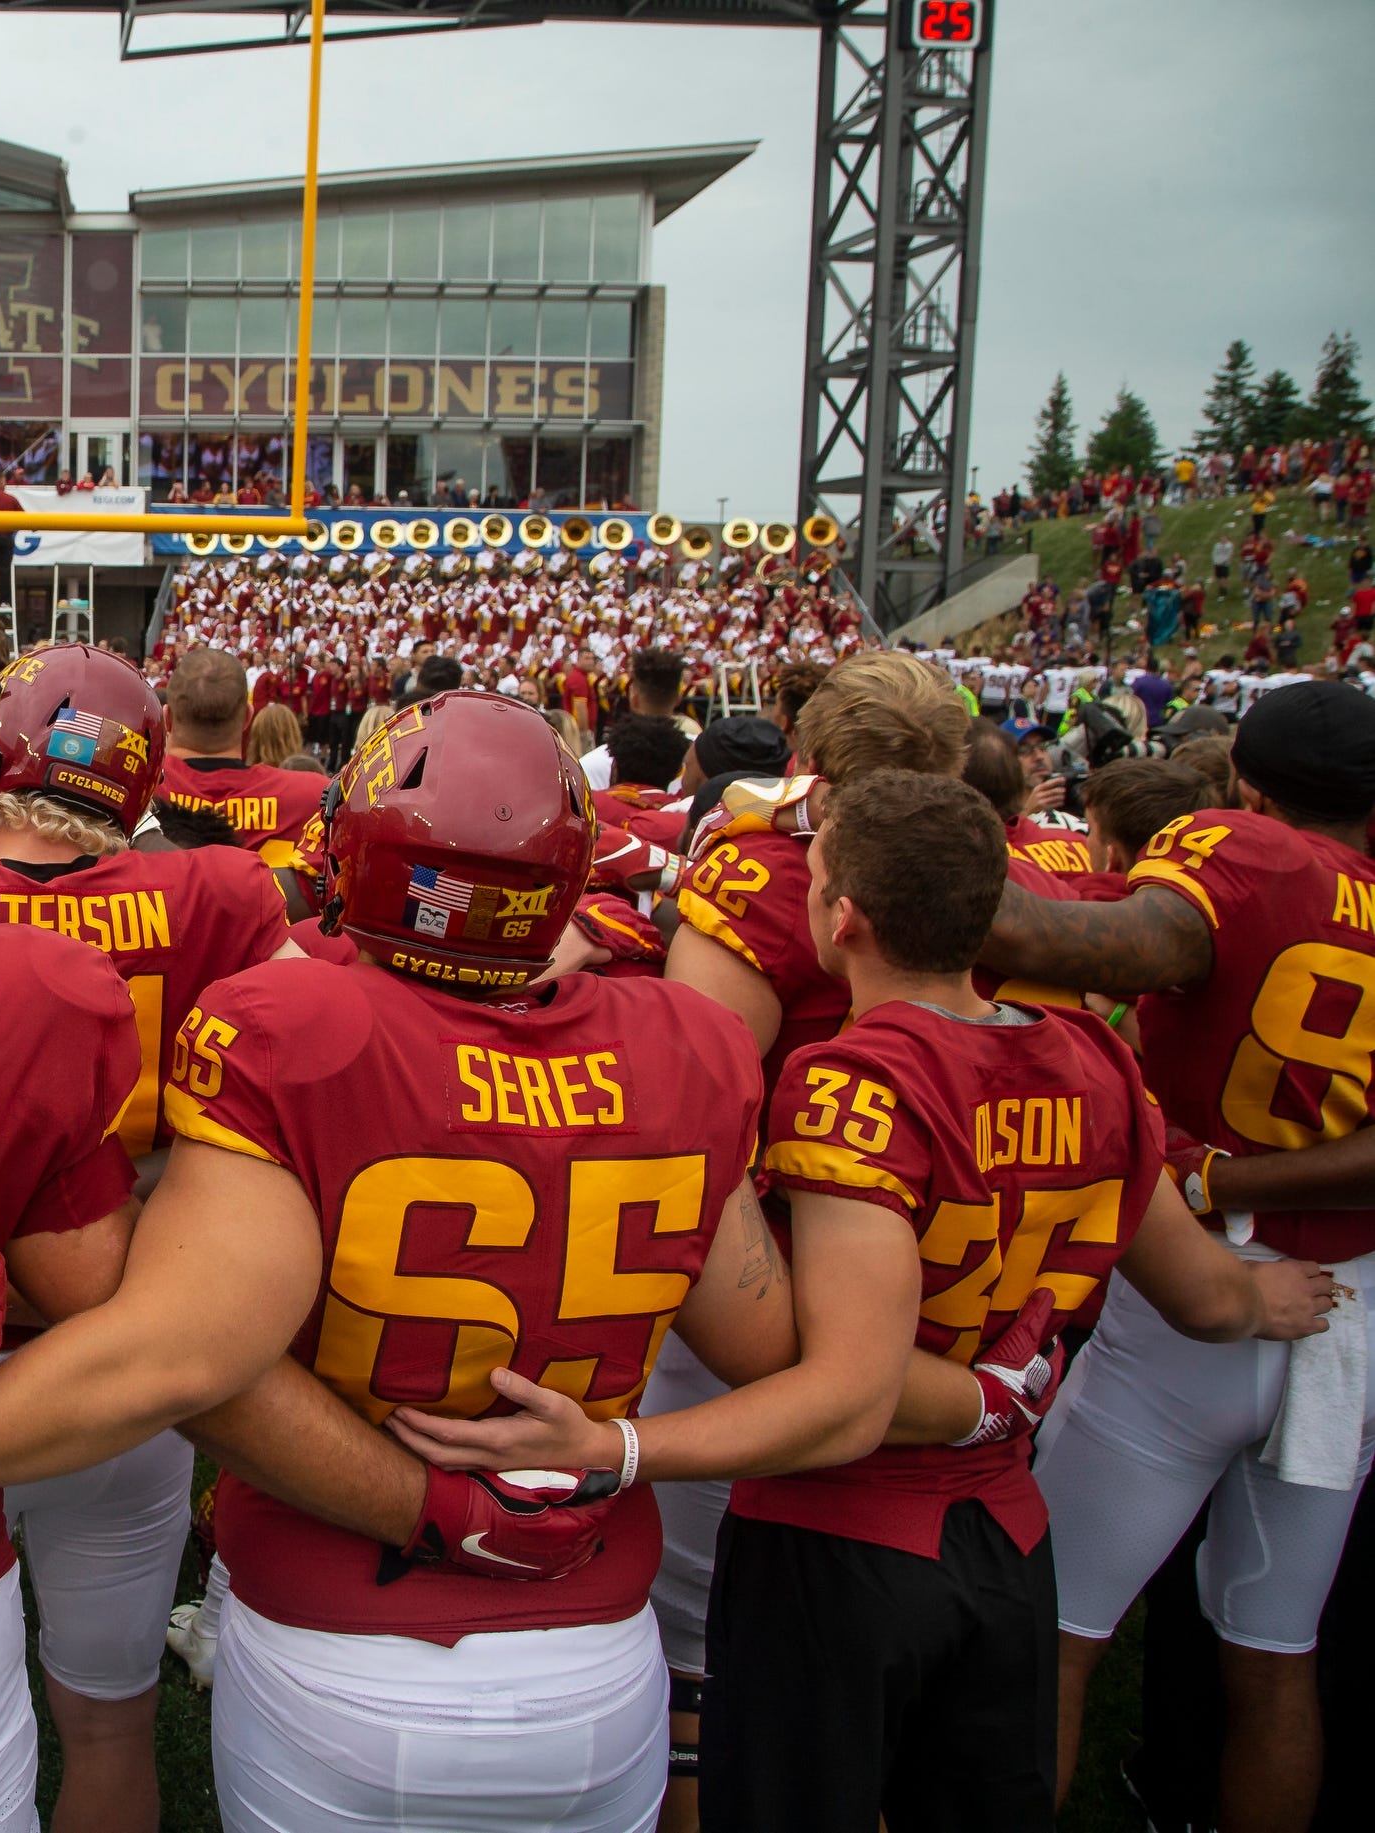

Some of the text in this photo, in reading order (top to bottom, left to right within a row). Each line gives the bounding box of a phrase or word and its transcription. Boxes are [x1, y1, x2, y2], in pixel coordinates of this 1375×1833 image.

[923, 0, 972, 41] 25
[155, 363, 602, 415] CYCLONES
[692, 842, 771, 919] 62
[1145, 814, 1233, 870] 84
[495, 884, 556, 918] XII
[502, 920, 533, 938] 65
[171, 1006, 239, 1098] 65
[457, 1044, 624, 1127] SERES
[793, 1066, 898, 1155] 35
[975, 1097, 1082, 1174] OLSON
[315, 1154, 707, 1426] 65
